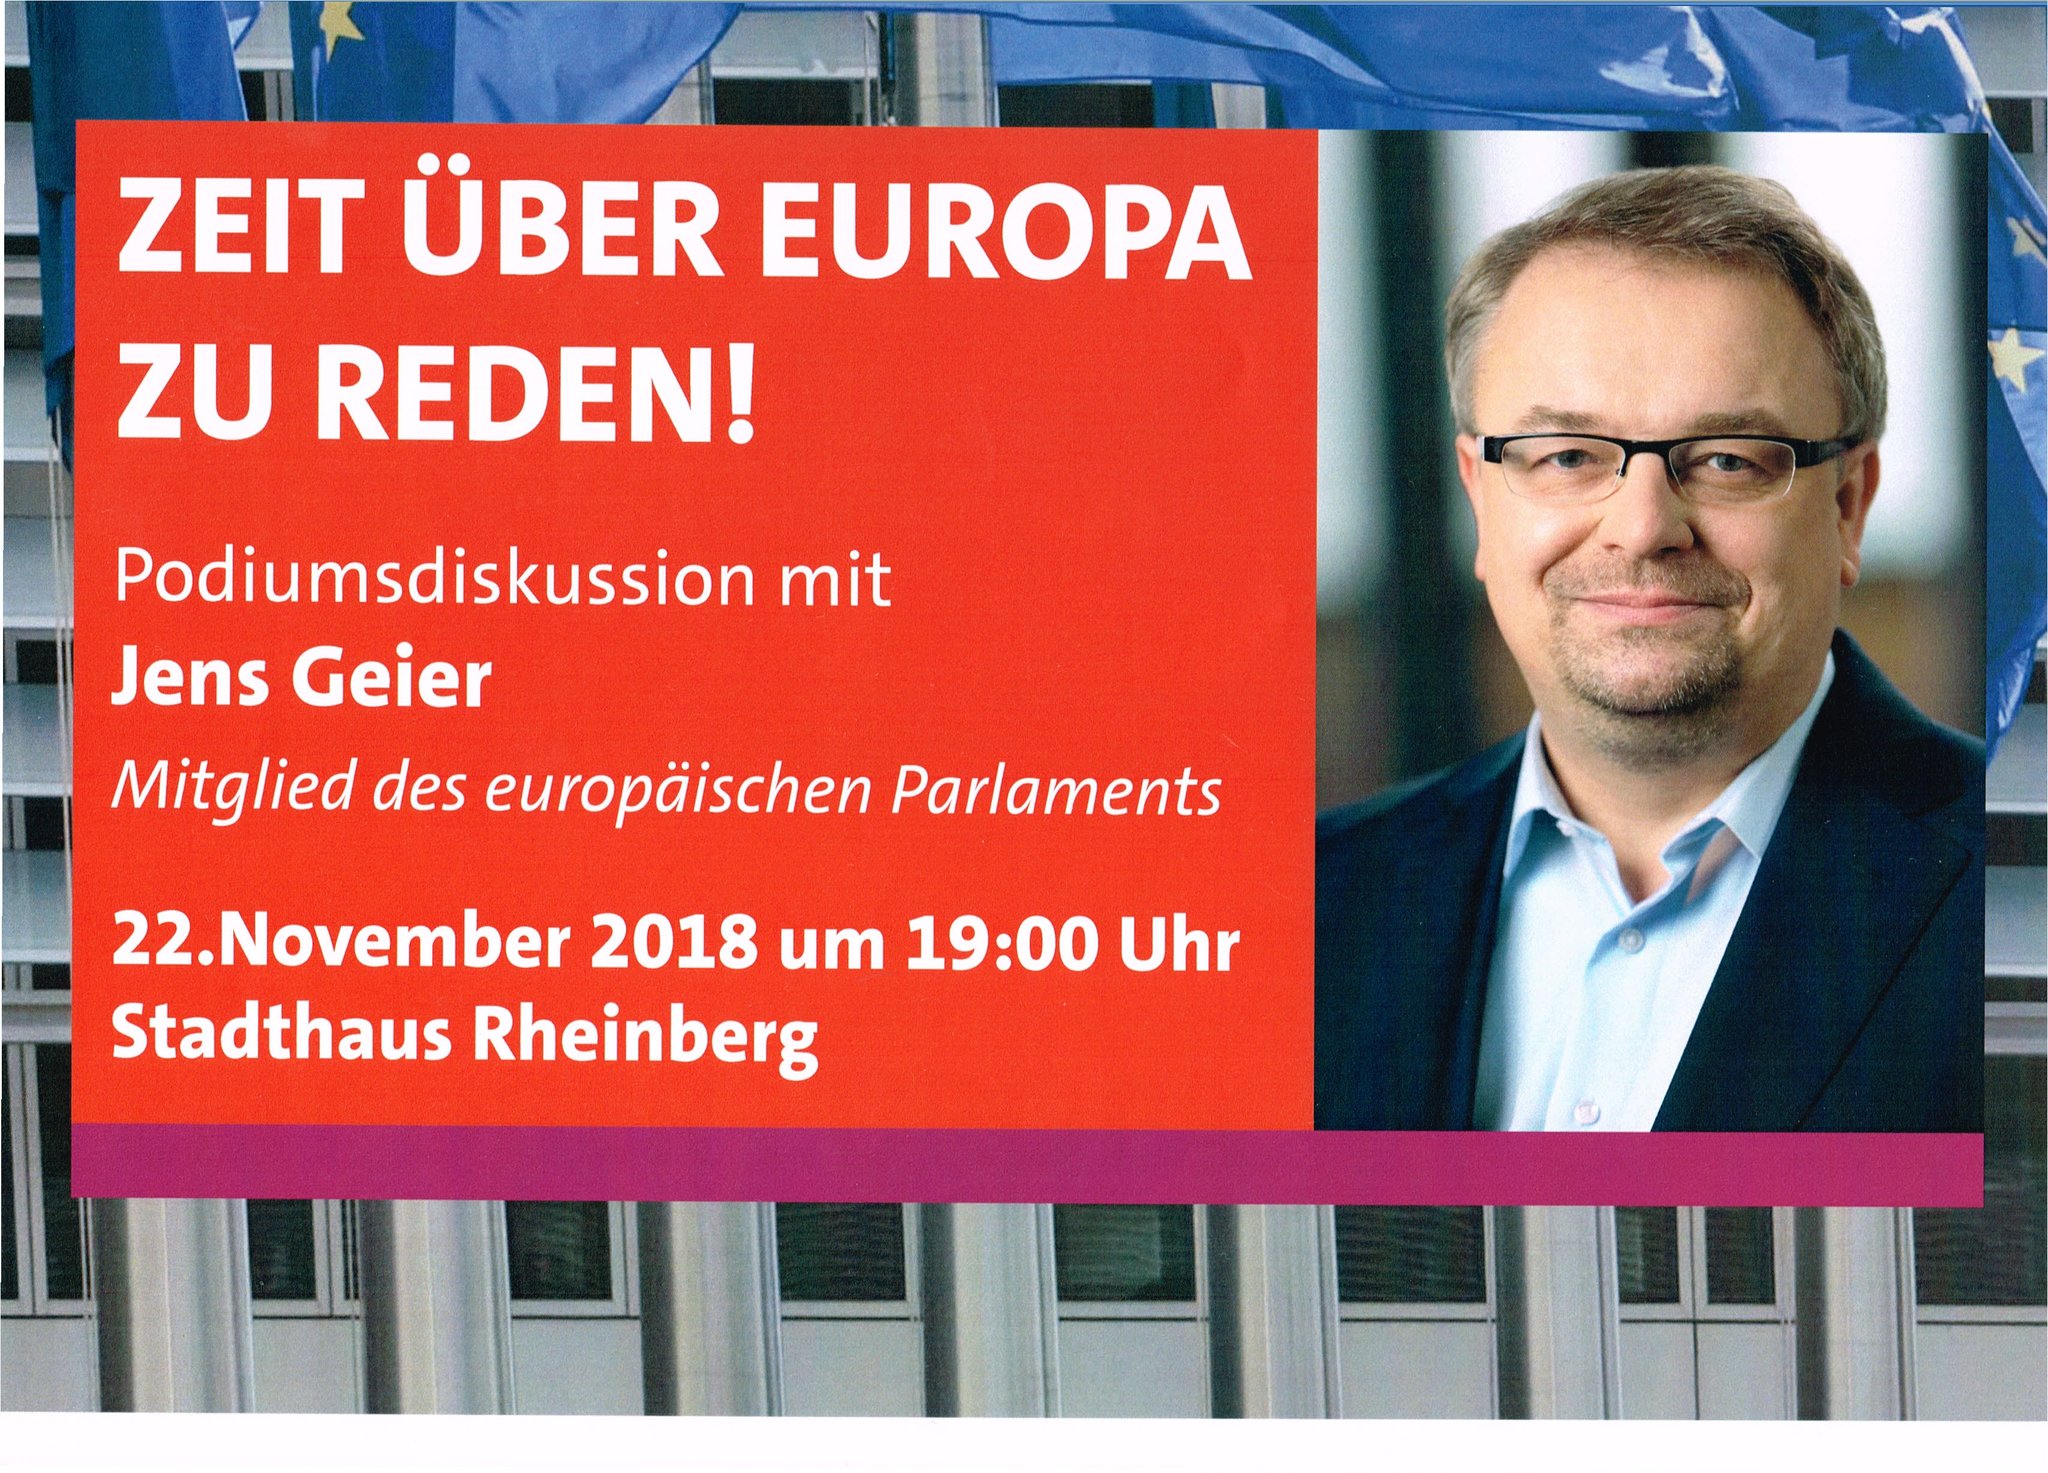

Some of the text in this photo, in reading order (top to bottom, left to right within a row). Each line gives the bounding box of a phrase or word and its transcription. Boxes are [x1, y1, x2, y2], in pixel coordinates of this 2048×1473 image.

[118, 152, 1253, 281] ZEIT ÜBER EUROPA
[117, 343, 755, 445] ZU REDEN!
[117, 543, 892, 607] Podiumsdiskussion mit
[111, 641, 493, 708] Jens Geier
[110, 757, 1222, 829] Mitglied des europäischen Parlaments
[113, 908, 1241, 972] 22.November 2018 um 19:00 Uhr
[112, 999, 819, 1082] Stadthaus Rheinberg
